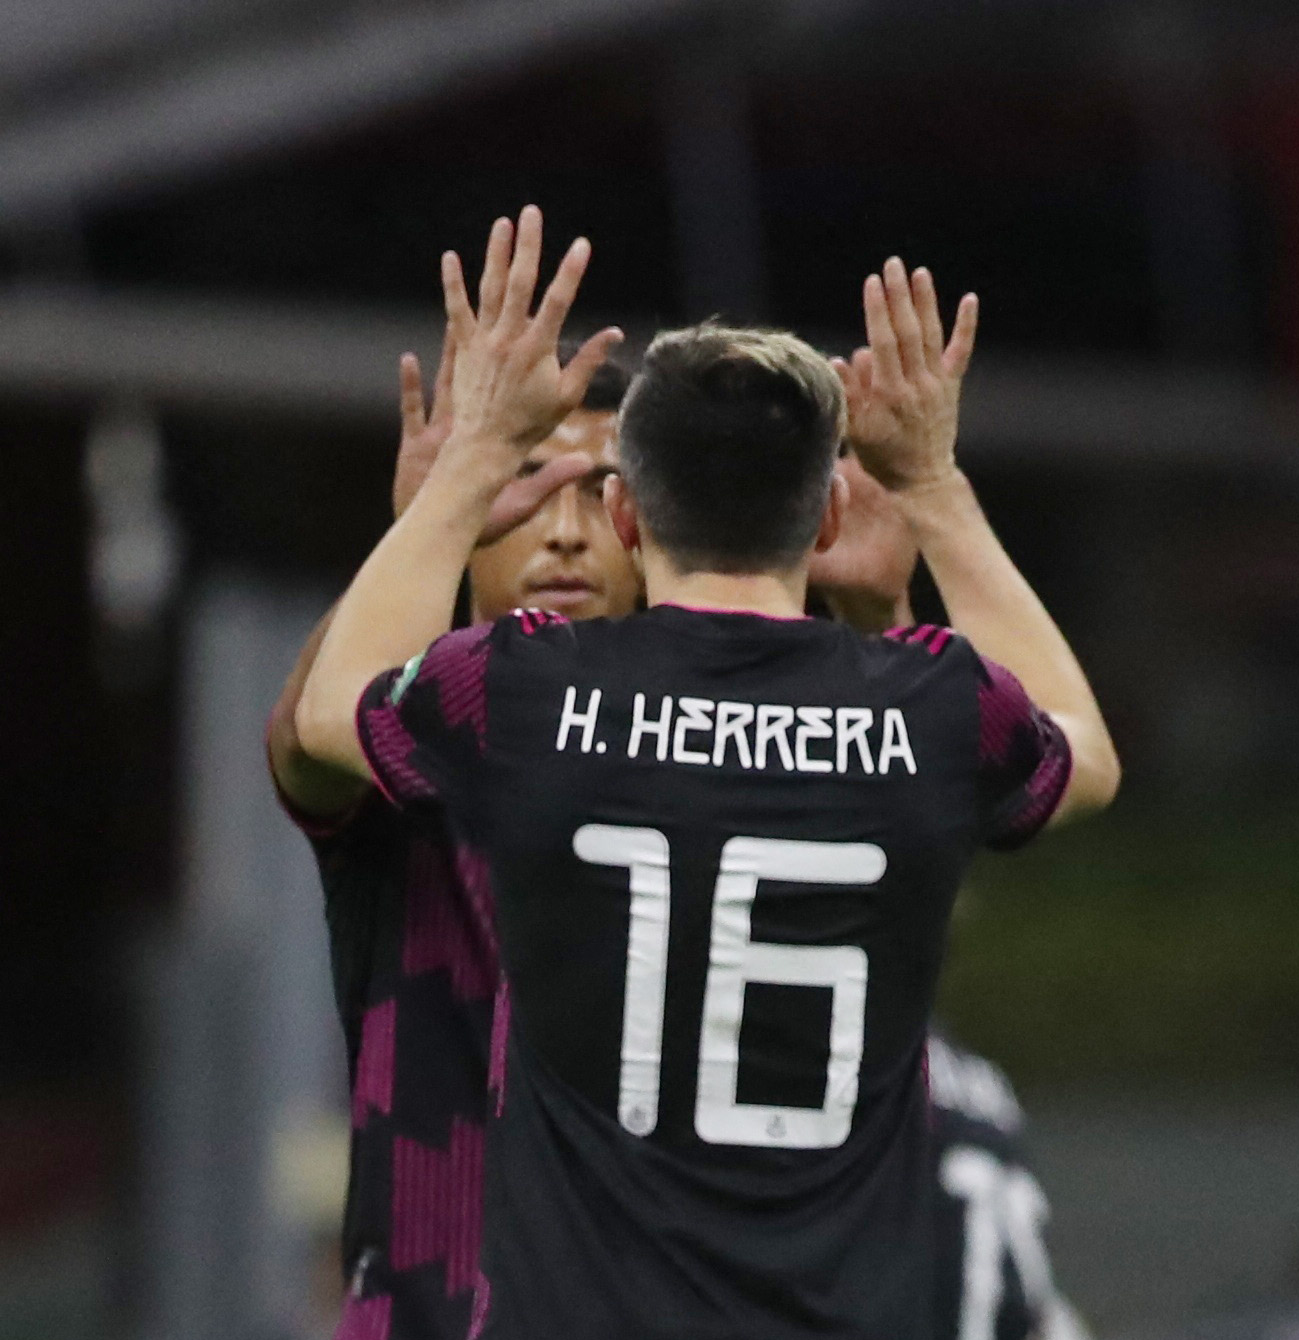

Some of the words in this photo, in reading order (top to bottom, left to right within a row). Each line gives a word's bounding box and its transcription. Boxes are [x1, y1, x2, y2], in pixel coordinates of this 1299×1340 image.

[557, 686, 607, 754] H.
[628, 692, 917, 775] HERRERA
[573, 823, 887, 1149] 16
